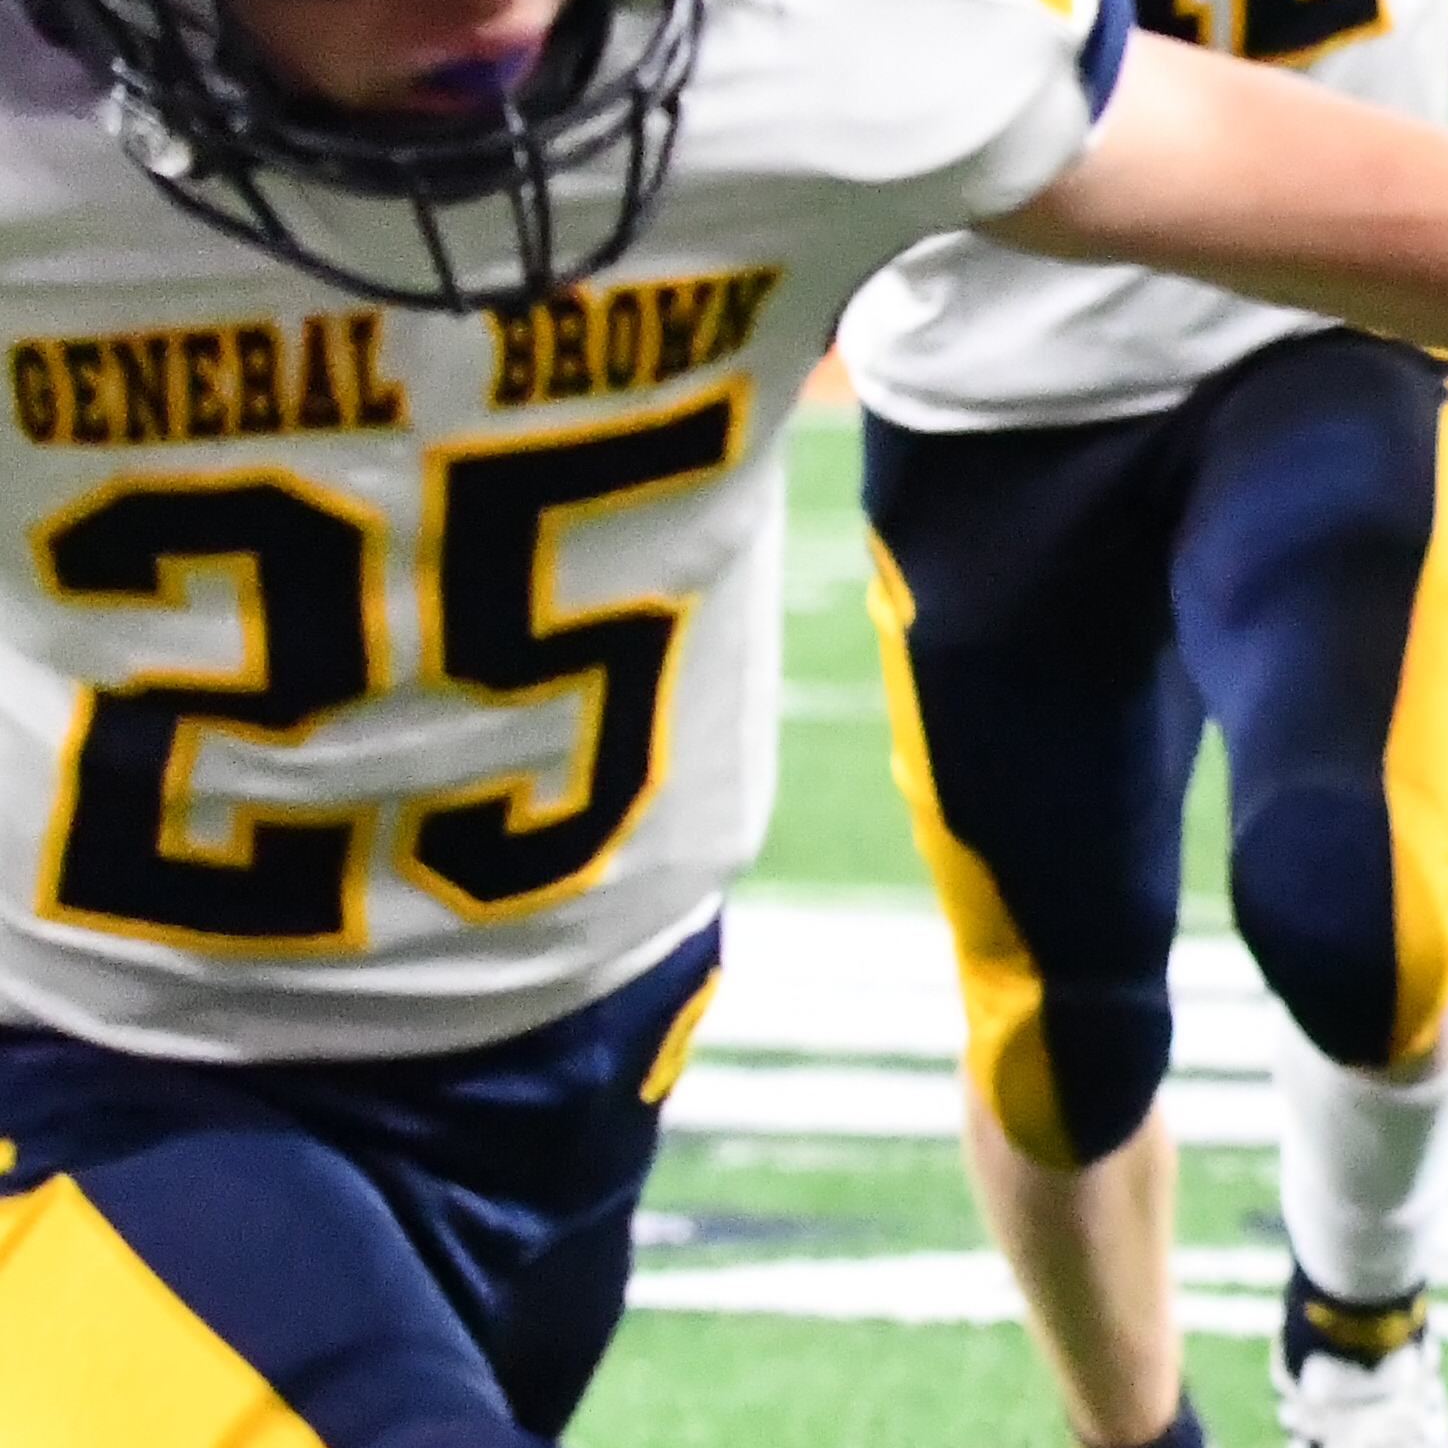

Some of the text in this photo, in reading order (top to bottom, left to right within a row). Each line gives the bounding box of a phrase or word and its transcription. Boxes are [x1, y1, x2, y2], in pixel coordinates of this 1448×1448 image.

[10, 265, 786, 446] GENERAL BROWN
[28, 374, 750, 954] 25
